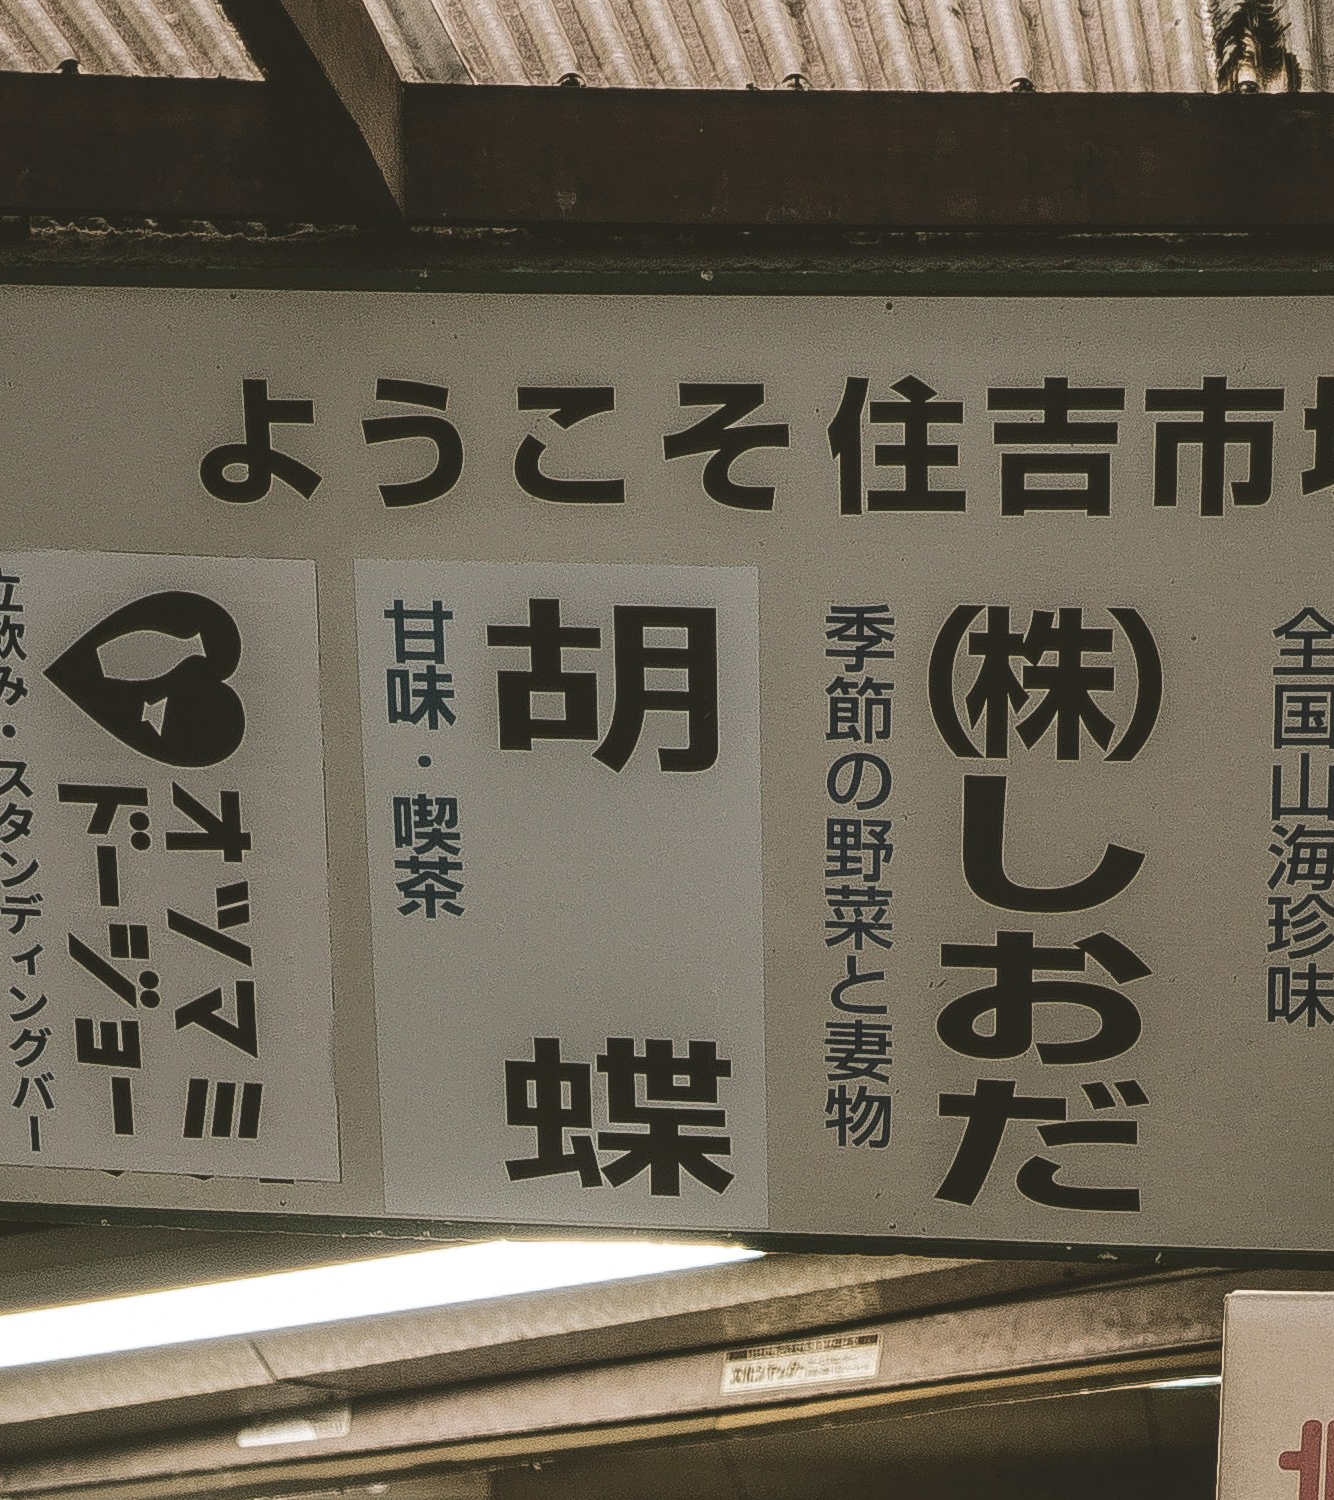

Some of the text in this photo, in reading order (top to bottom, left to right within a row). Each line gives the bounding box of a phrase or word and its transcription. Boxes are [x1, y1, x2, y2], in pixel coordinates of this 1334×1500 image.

[383, 599, 466, 920] 甘味・喫茶
[823, 603, 897, 1150] 季節の野菜と妻物
[926, 602, 1164, 1214] (株)しおだ
[57, 783, 164, 1137] ドージョー
[165, 783, 264, 1140] オツマミ
